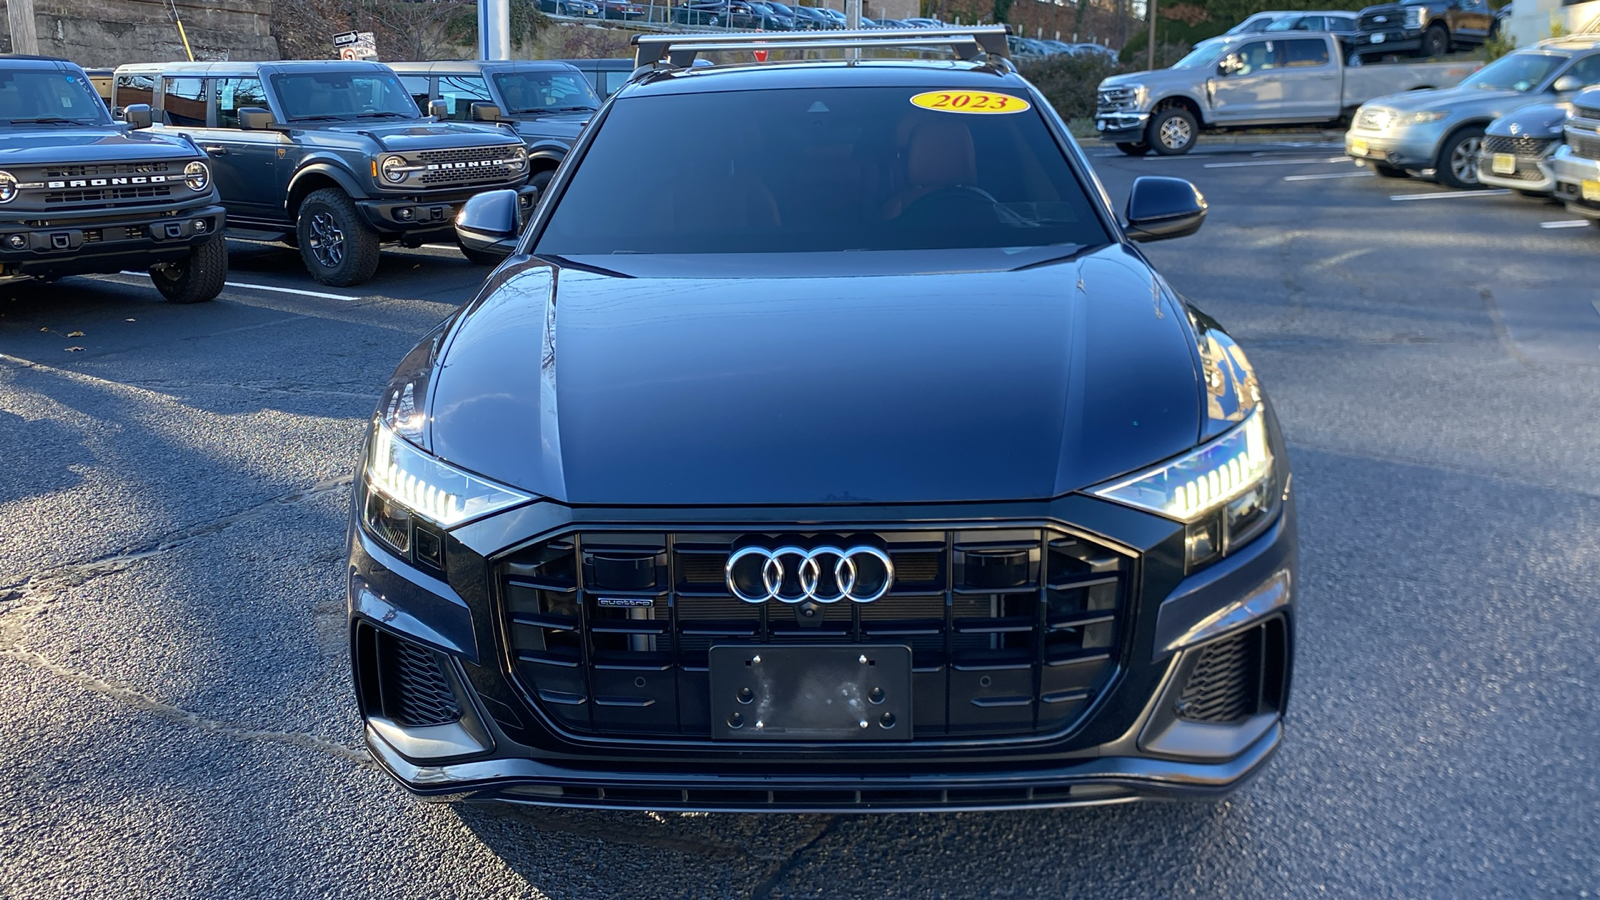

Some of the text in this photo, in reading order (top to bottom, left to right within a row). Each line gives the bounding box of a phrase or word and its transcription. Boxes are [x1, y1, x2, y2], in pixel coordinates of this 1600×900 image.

[931, 95, 1008, 109] 2023
[427, 160, 503, 170] BRONCO
[48, 175, 166, 189] BRONCO
